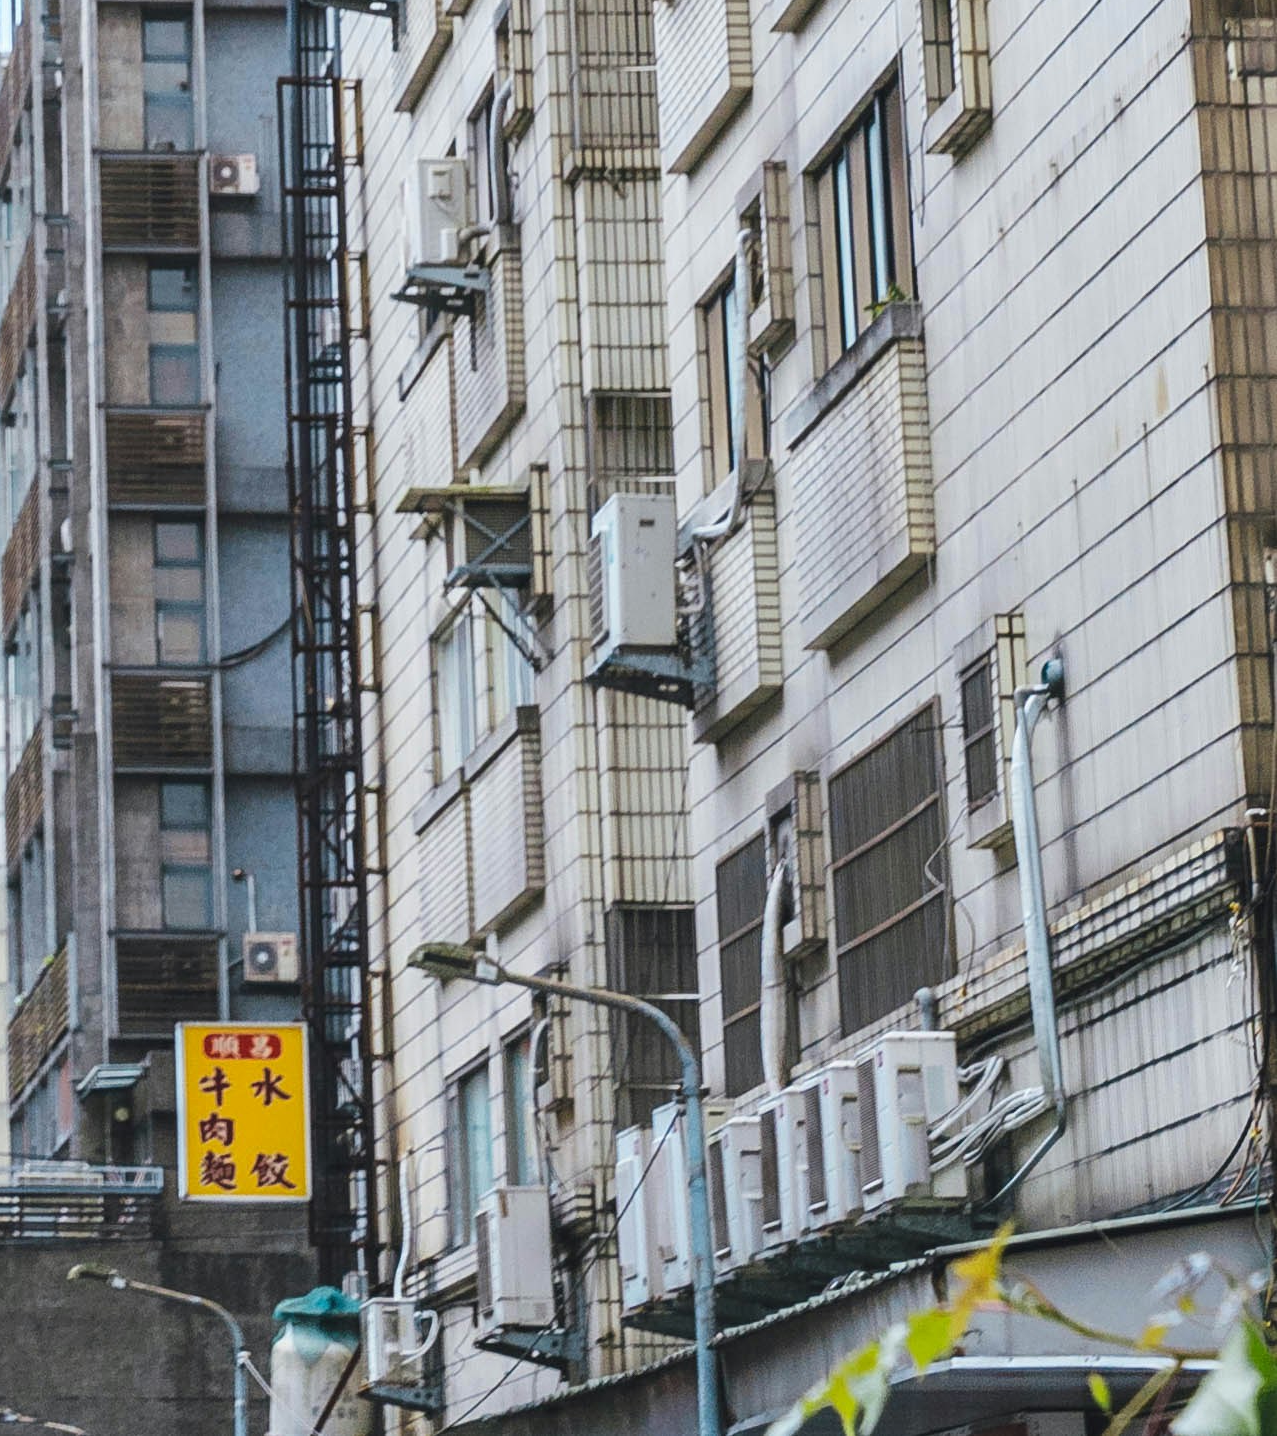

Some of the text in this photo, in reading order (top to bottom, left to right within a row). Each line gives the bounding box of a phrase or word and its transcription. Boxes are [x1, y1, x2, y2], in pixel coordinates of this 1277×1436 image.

[198, 1066, 237, 1190] 牛肉麵
[249, 1066, 297, 1189] 水餃
